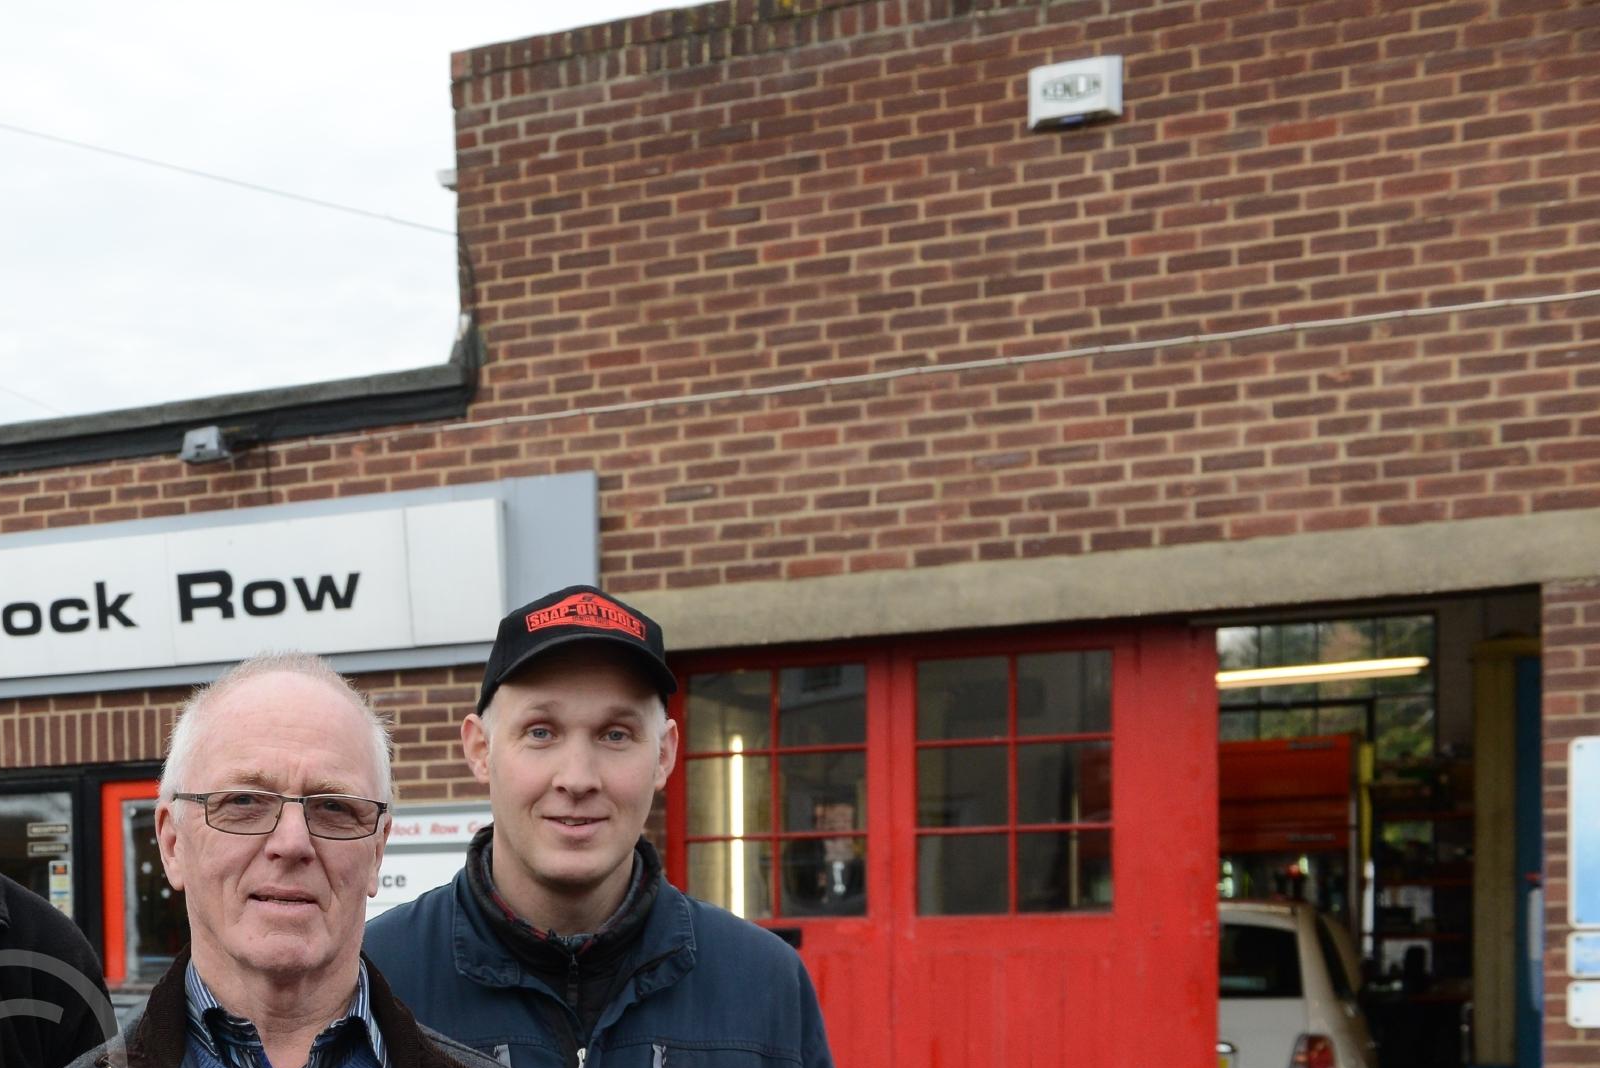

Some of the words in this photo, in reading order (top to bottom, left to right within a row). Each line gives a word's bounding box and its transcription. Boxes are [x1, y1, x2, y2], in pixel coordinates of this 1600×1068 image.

[175, 568, 362, 624] Row
[528, 603, 599, 628] SNAP-ON
[599, 605, 641, 635] TOOLS
[430, 822, 459, 835] Row
[379, 874, 407, 888] ce
